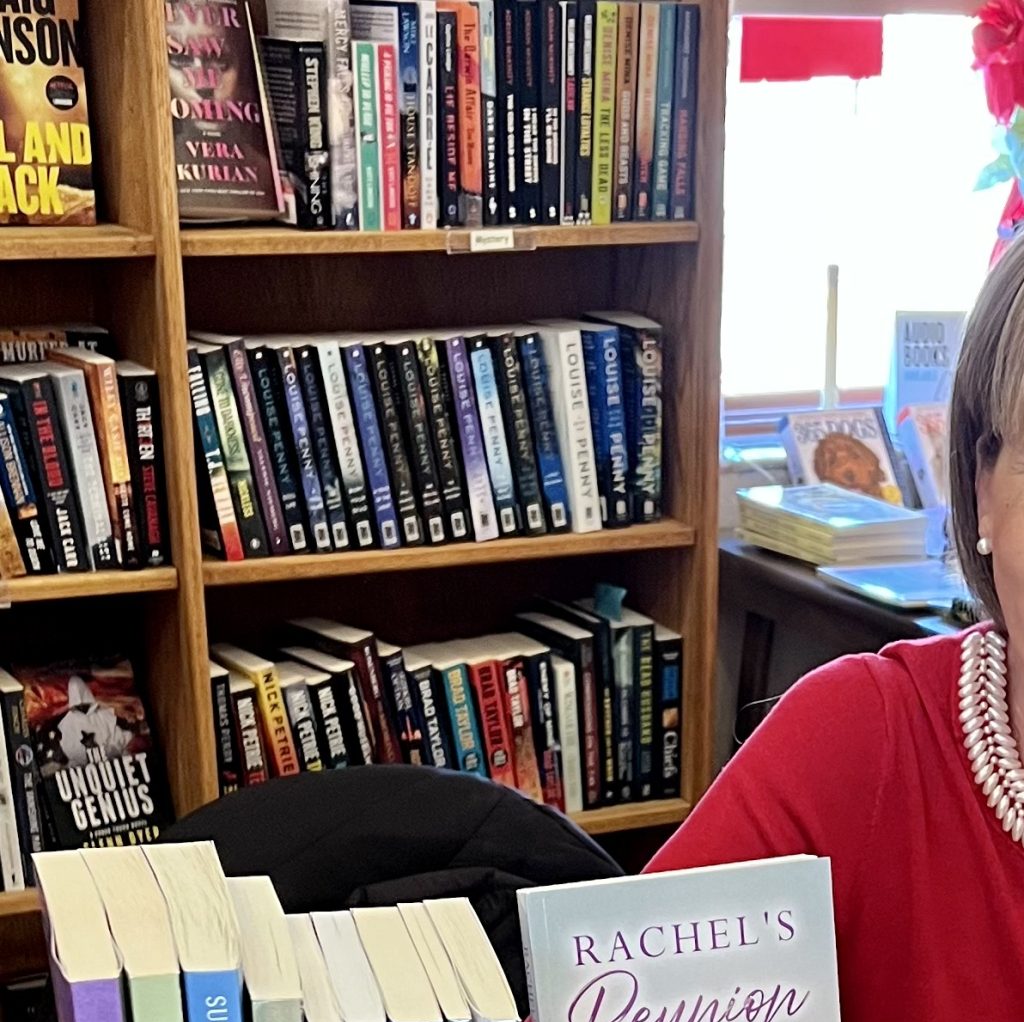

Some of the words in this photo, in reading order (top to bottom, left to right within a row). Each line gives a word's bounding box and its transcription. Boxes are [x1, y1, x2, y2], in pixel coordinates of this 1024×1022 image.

[464, 23, 475, 42] The
[305, 57, 321, 113] STEPHEN
[464, 45, 476, 84] Darwin
[465, 88, 478, 121] Affair
[600, 108, 610, 128] THE
[23, 121, 92, 166] AND
[186, 140, 245, 160] VERA
[600, 132, 610, 159] LESS
[177, 164, 258, 184] KURIAN
[599, 162, 609, 193] DEAD
[567, 343, 584, 411] LOUISE
[603, 338, 621, 407] LOUISE
[284, 365, 303, 425] LOUISE
[297, 427, 314, 480] PENNY
[328, 363, 346, 424] LOUISE
[342, 427, 359, 480] PENNY
[403, 361, 420, 419] LOUISE
[414, 422, 430, 474] PENNY
[575, 438, 593, 499] PENNY
[609, 432, 628, 494] PENNY
[262, 672, 283, 712] NICK
[318, 686, 337, 719] NICK
[419, 679, 434, 717] BRAD
[448, 669, 467, 703] BRAD
[478, 667, 496, 701] BRAD
[272, 715, 295, 773] PETRIE
[426, 718, 447, 768] TAYLOR
[455, 704, 475, 749] TAYLOR
[484, 703, 502, 750] TAYLOR
[55, 753, 151, 802] UNQUIET
[664, 731, 678, 778] Chiefs
[71, 784, 155, 831] GENIUS
[573, 910, 796, 966] RACHEL'S
